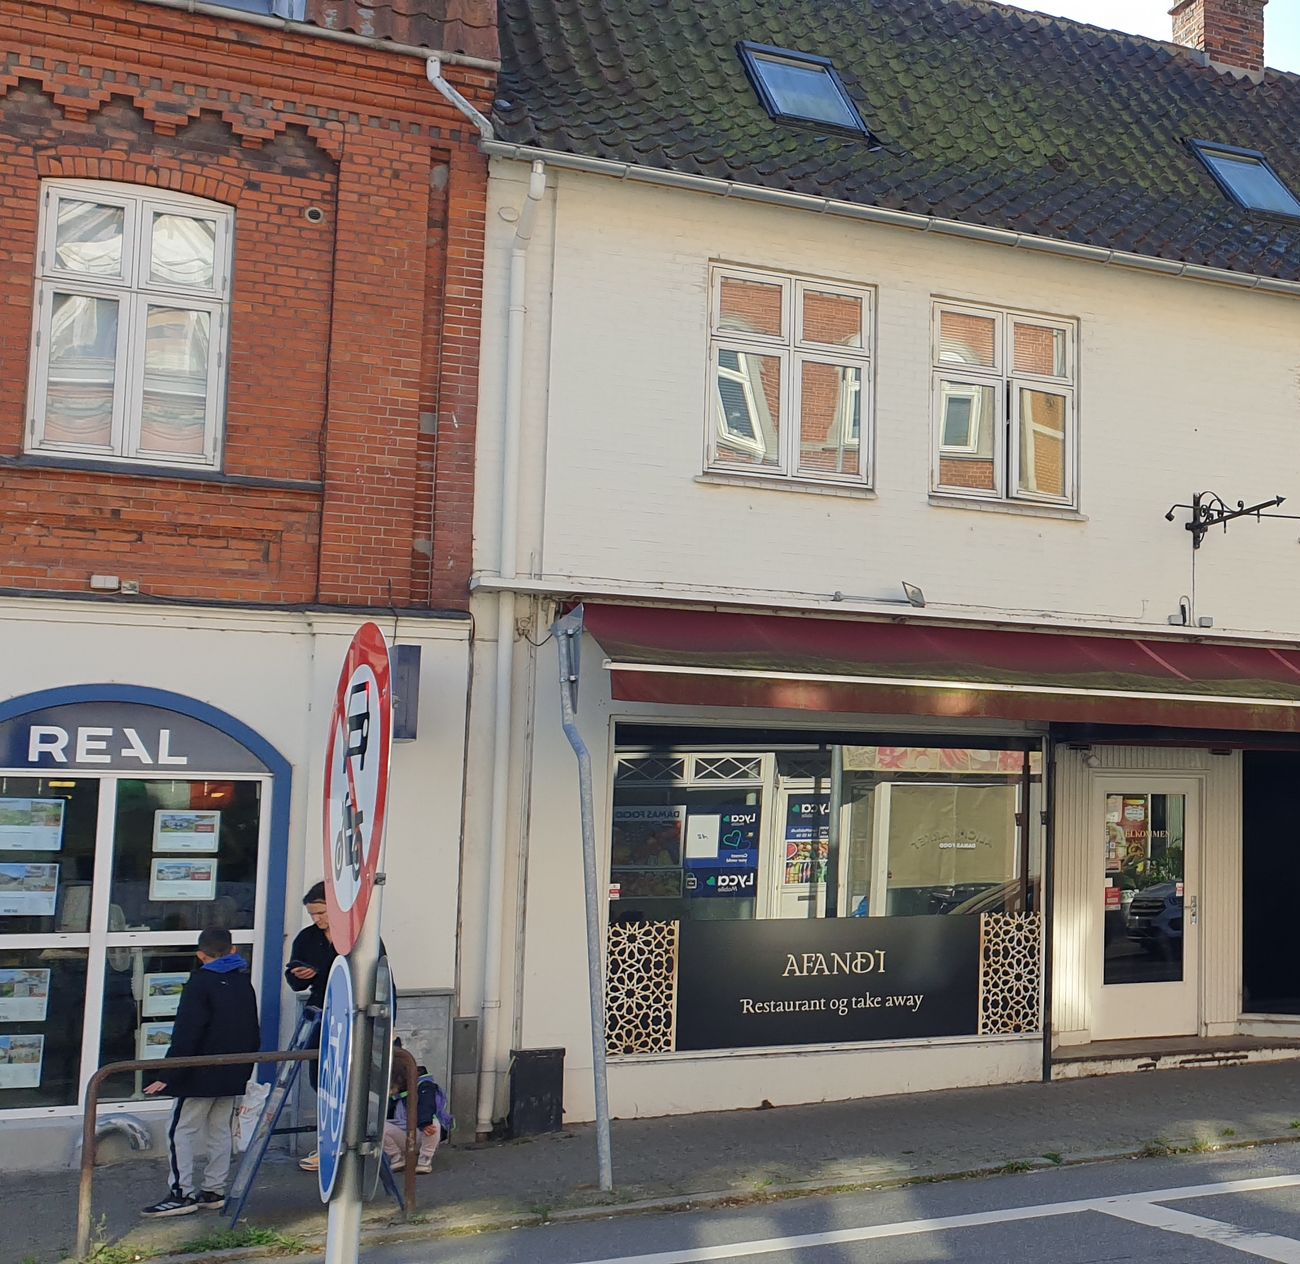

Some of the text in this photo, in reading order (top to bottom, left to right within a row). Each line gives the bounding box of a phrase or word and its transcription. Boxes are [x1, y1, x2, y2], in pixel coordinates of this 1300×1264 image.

[28, 726, 188, 765] REAL
[740, 992, 924, 1016] Restaurant og take away
